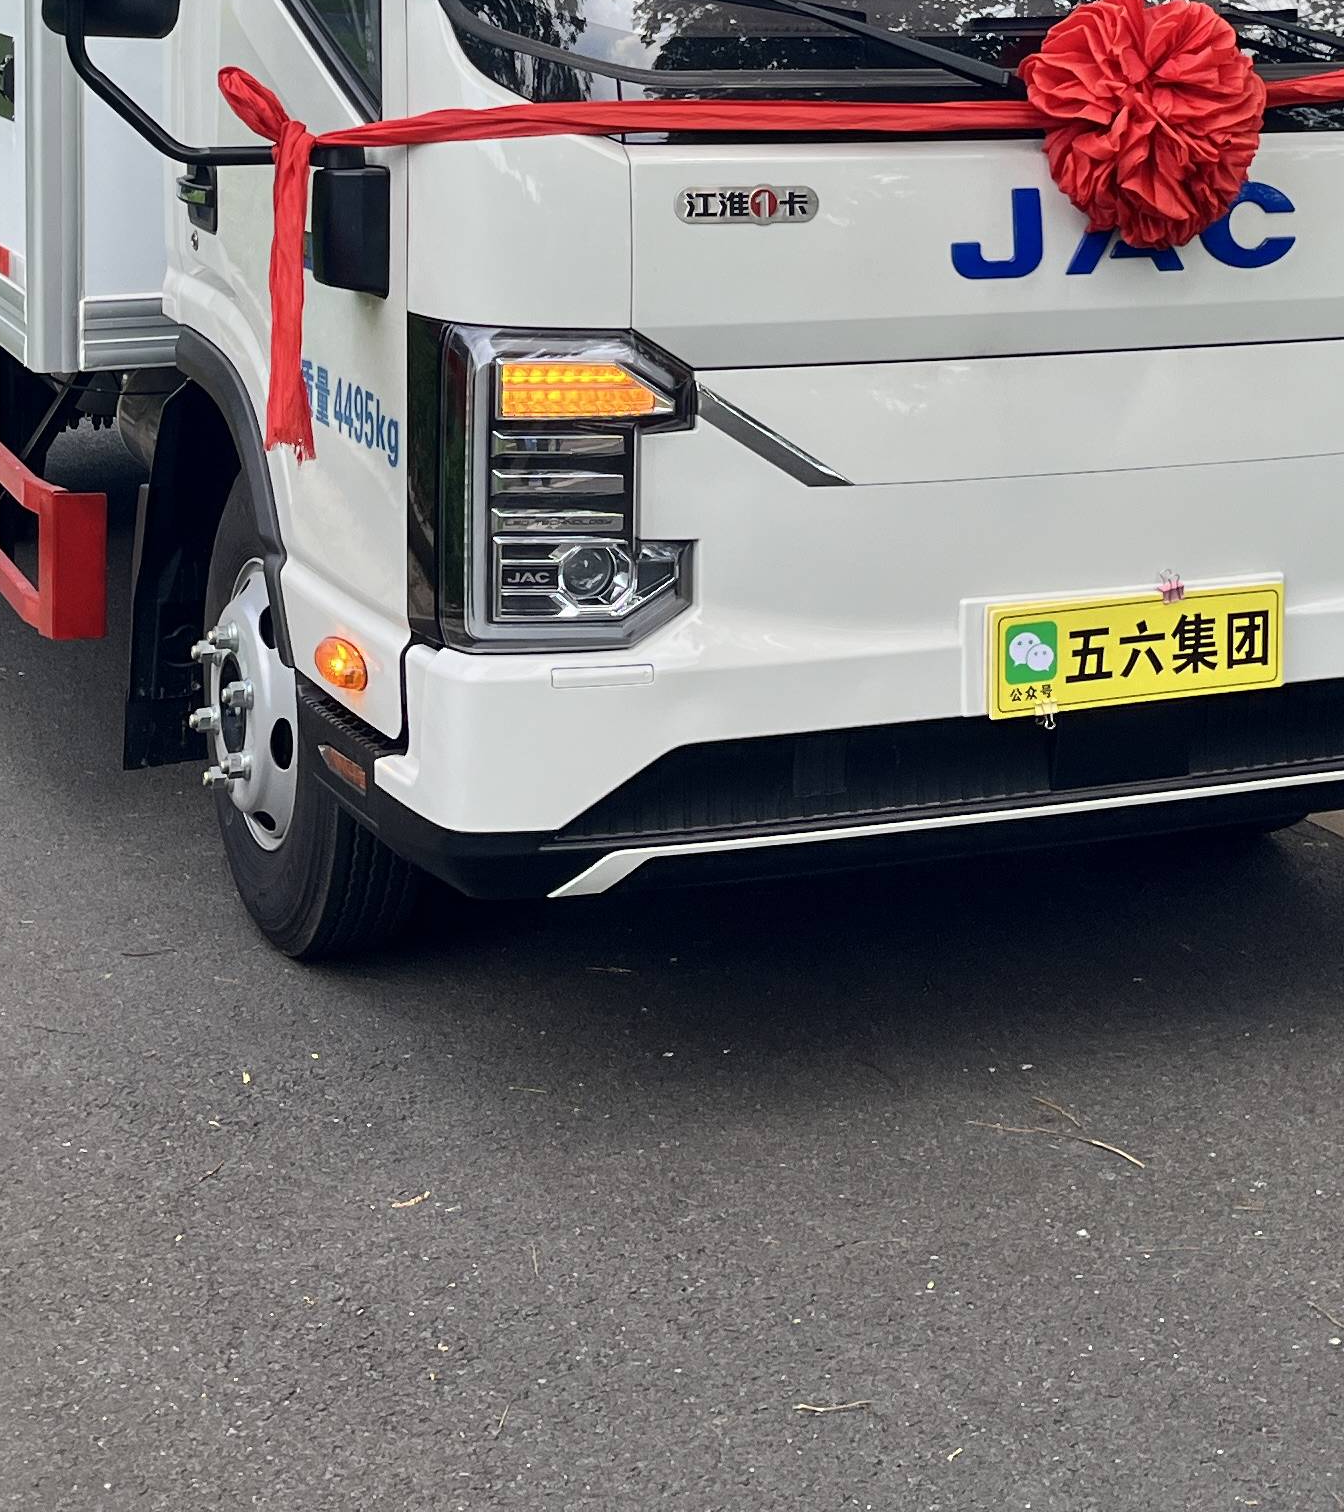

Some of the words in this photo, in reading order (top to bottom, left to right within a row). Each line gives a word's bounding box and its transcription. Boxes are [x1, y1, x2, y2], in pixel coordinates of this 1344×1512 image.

[507, 572, 550, 584] JAC
[1065, 609, 1270, 684] 五六集团
[1009, 684, 1053, 702] 公众号
